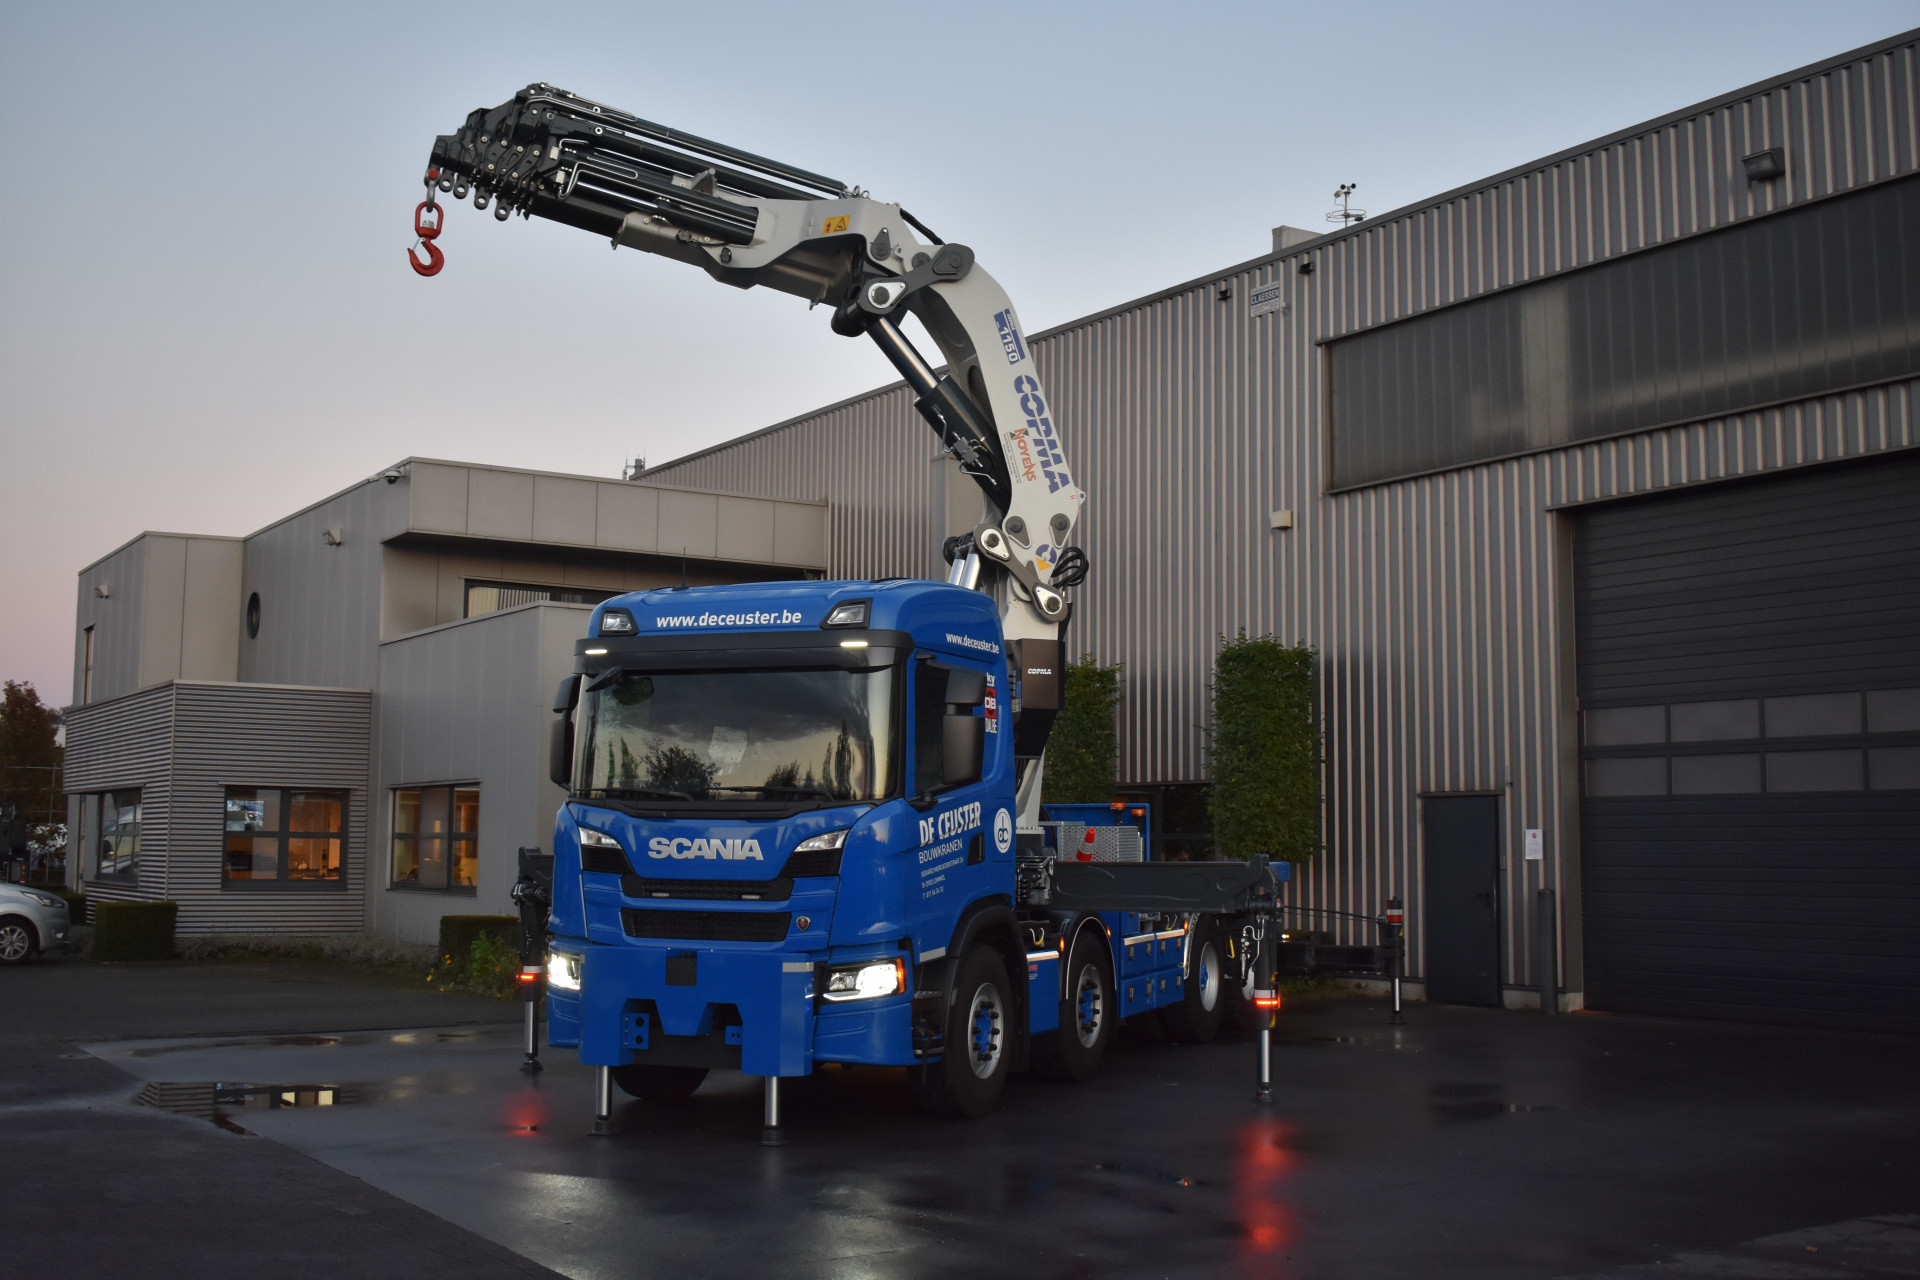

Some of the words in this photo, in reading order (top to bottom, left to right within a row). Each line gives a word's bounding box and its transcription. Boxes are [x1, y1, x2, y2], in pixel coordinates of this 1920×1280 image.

[1250, 289, 1280, 305] CLAESSEN
[1000, 326, 1019, 362] 1150
[1013, 374, 1070, 495] COPMA
[1012, 427, 1037, 482] NOYENS
[656, 609, 802, 628] www.deceuster.be
[945, 633, 1000, 654] www.deceuster.be
[919, 817, 935, 847] DE
[938, 801, 981, 840] CEUSTER
[648, 837, 764, 861] SCANIA
[919, 838, 963, 864] BOUWKRANEN
